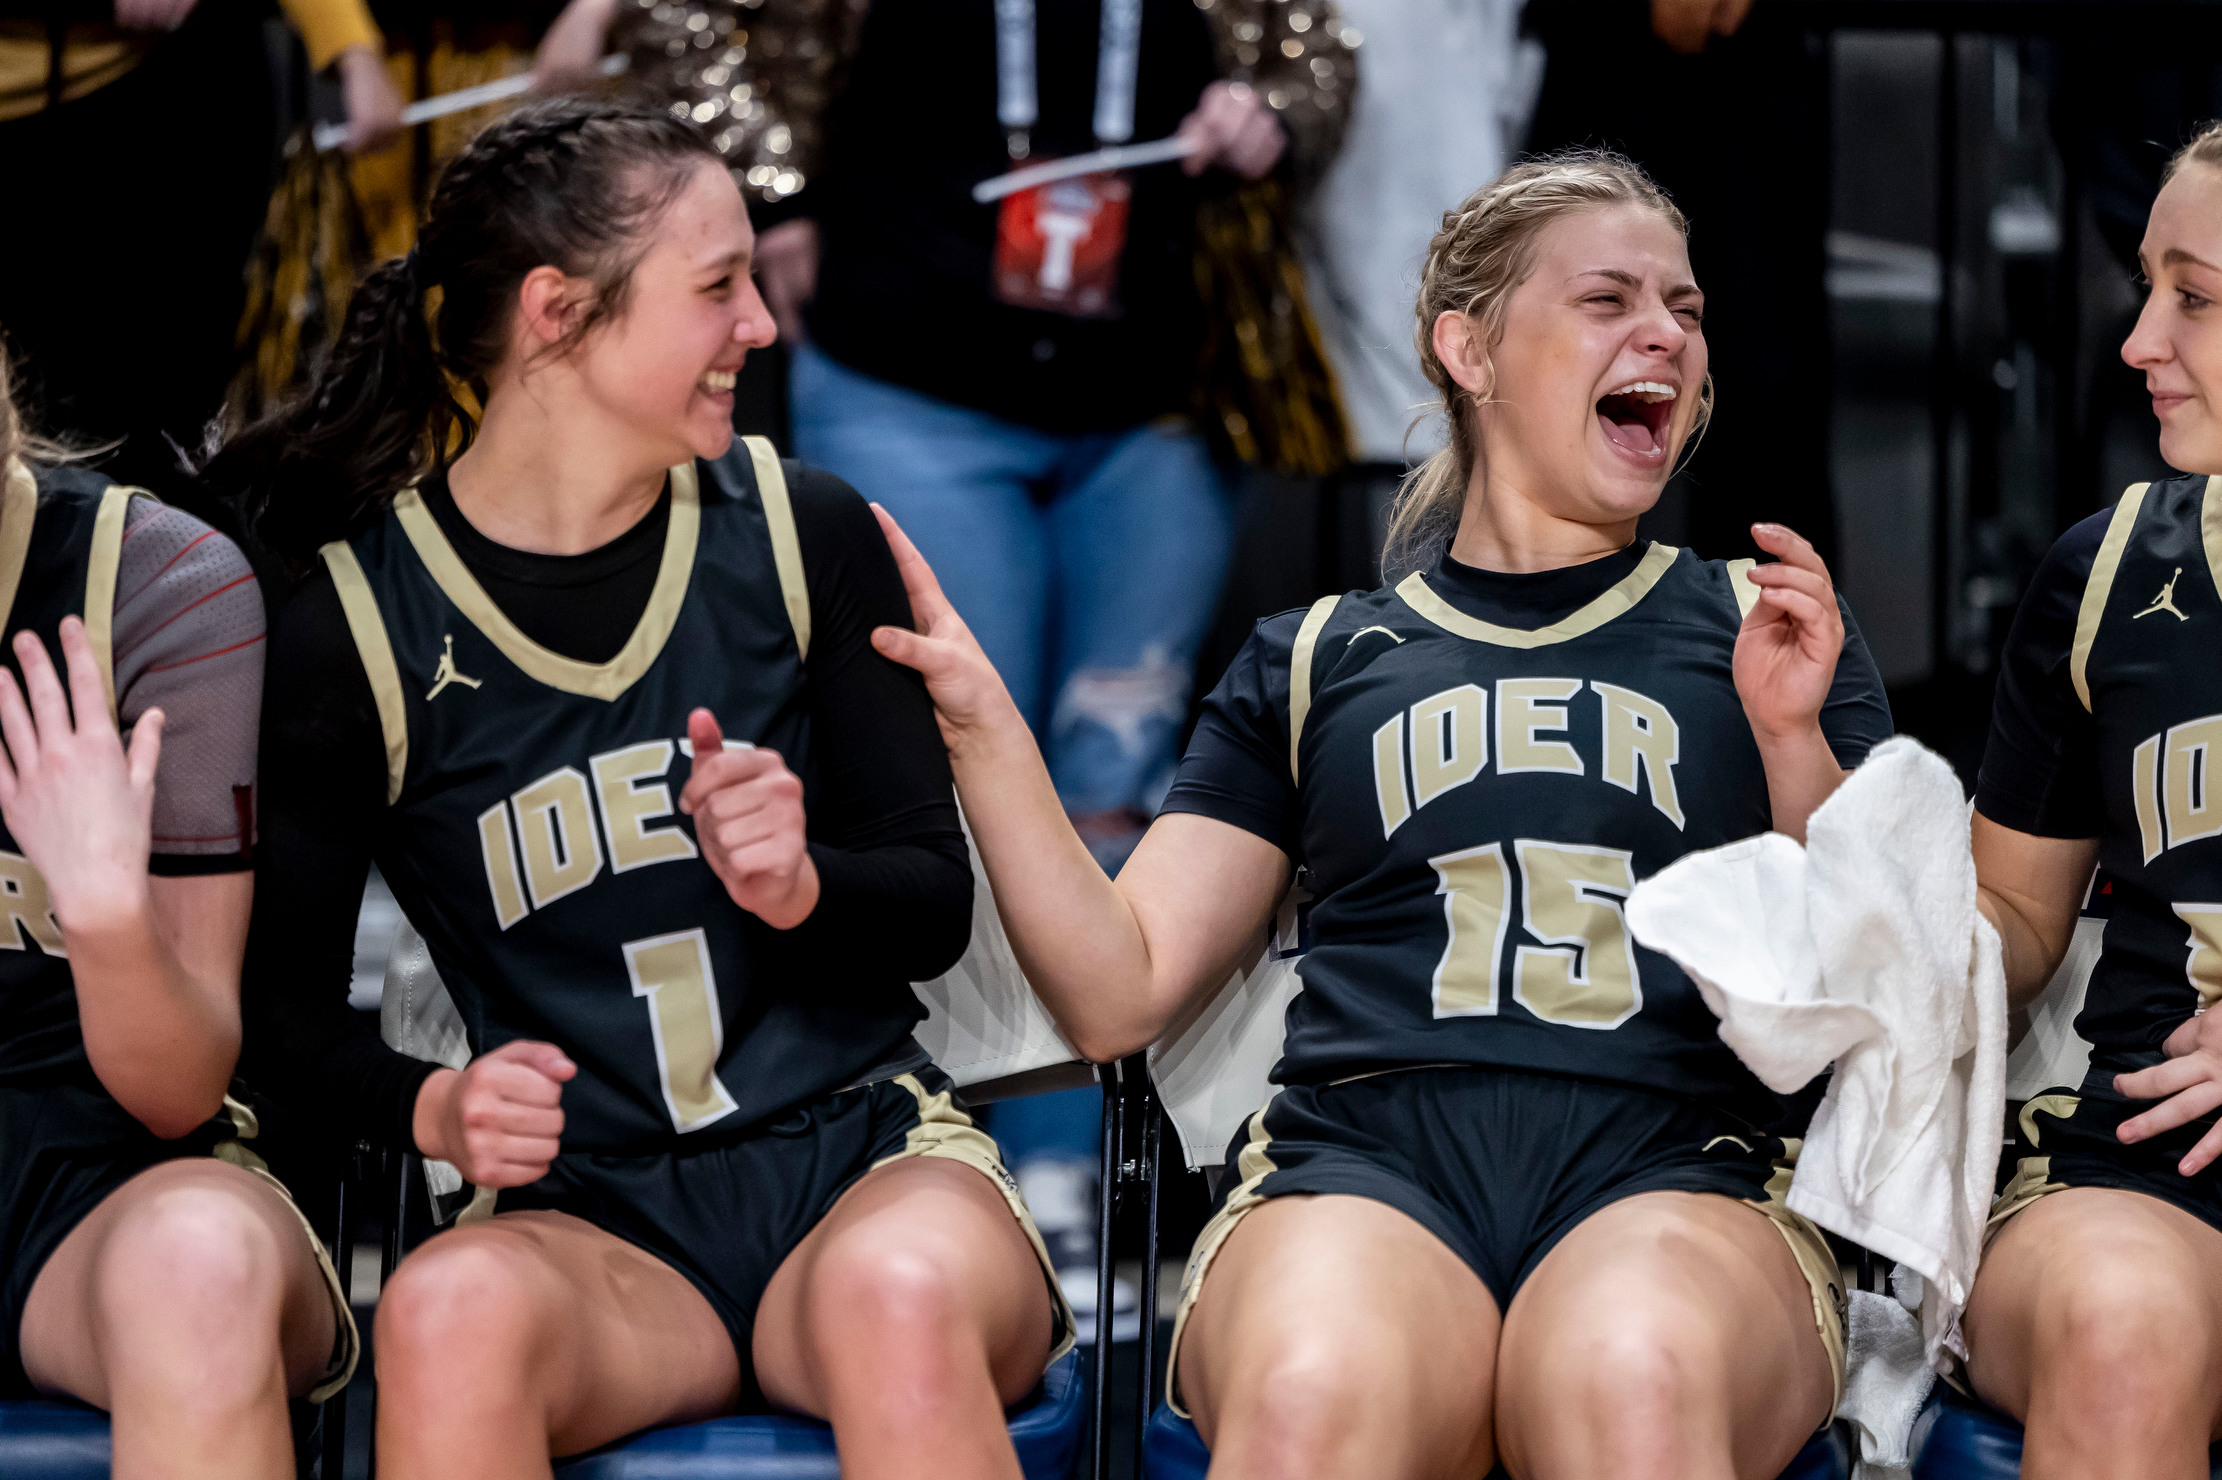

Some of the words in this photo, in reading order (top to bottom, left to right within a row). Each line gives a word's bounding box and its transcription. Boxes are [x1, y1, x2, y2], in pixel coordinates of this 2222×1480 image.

[477, 738, 756, 932] IDE
[1373, 677, 1686, 841] IDER
[621, 927, 740, 1134] 1
[1427, 838, 1643, 1031] 15
